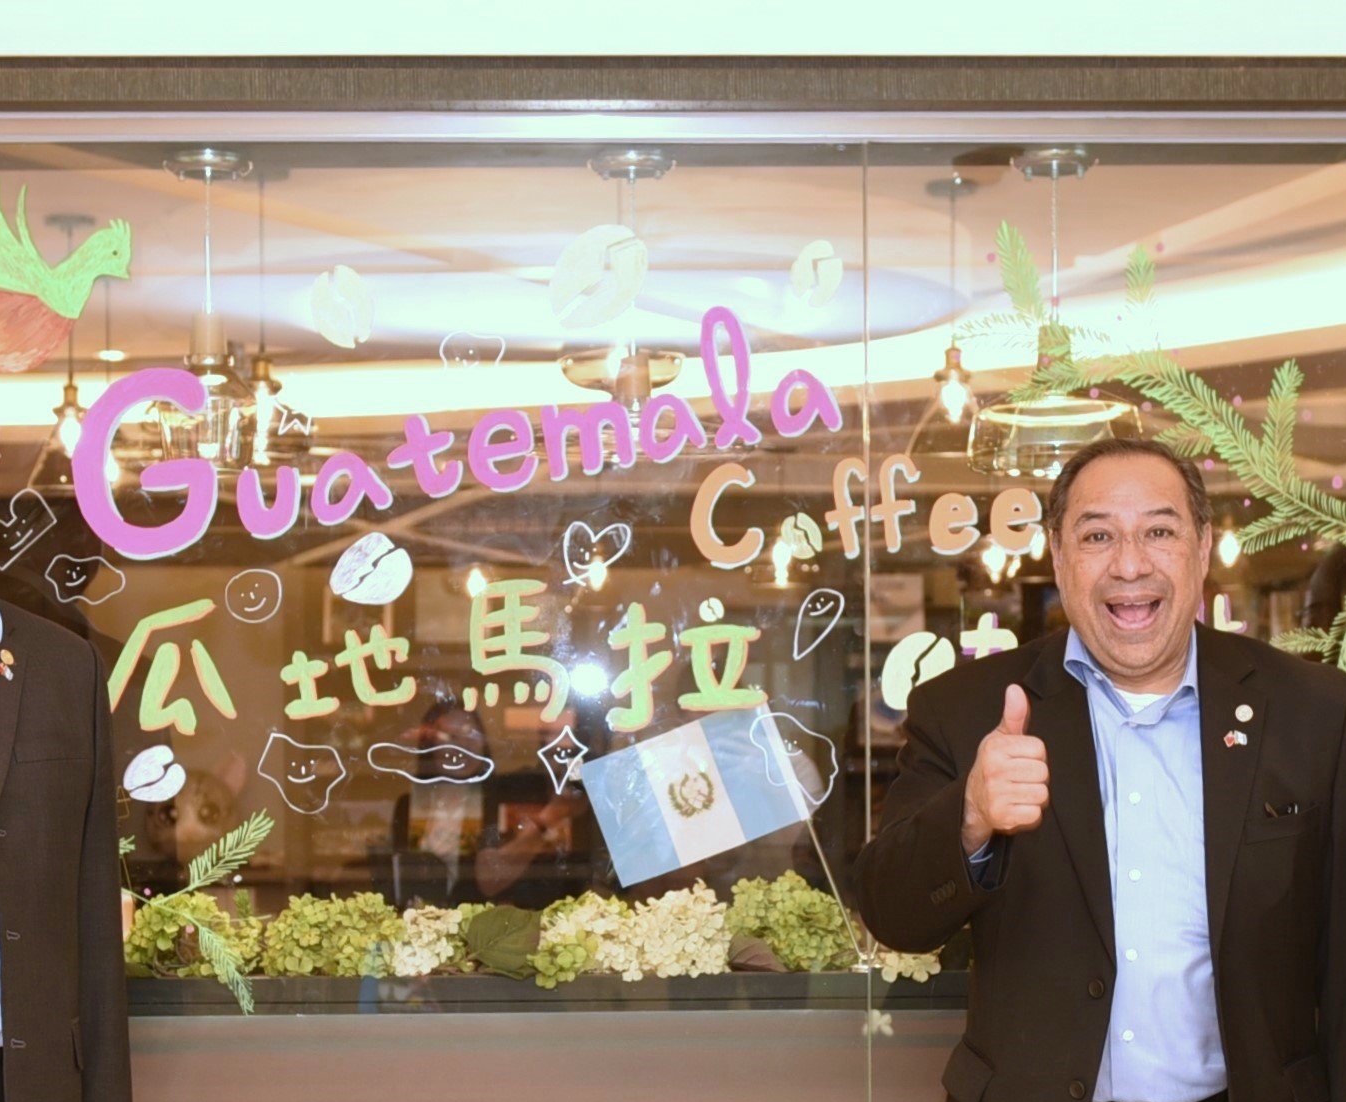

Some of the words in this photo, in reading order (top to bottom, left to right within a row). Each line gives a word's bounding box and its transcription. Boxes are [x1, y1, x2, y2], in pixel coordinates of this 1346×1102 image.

[72, 306, 844, 560] Guatemala
[108, 579, 769, 736] 瓜地馬拉
